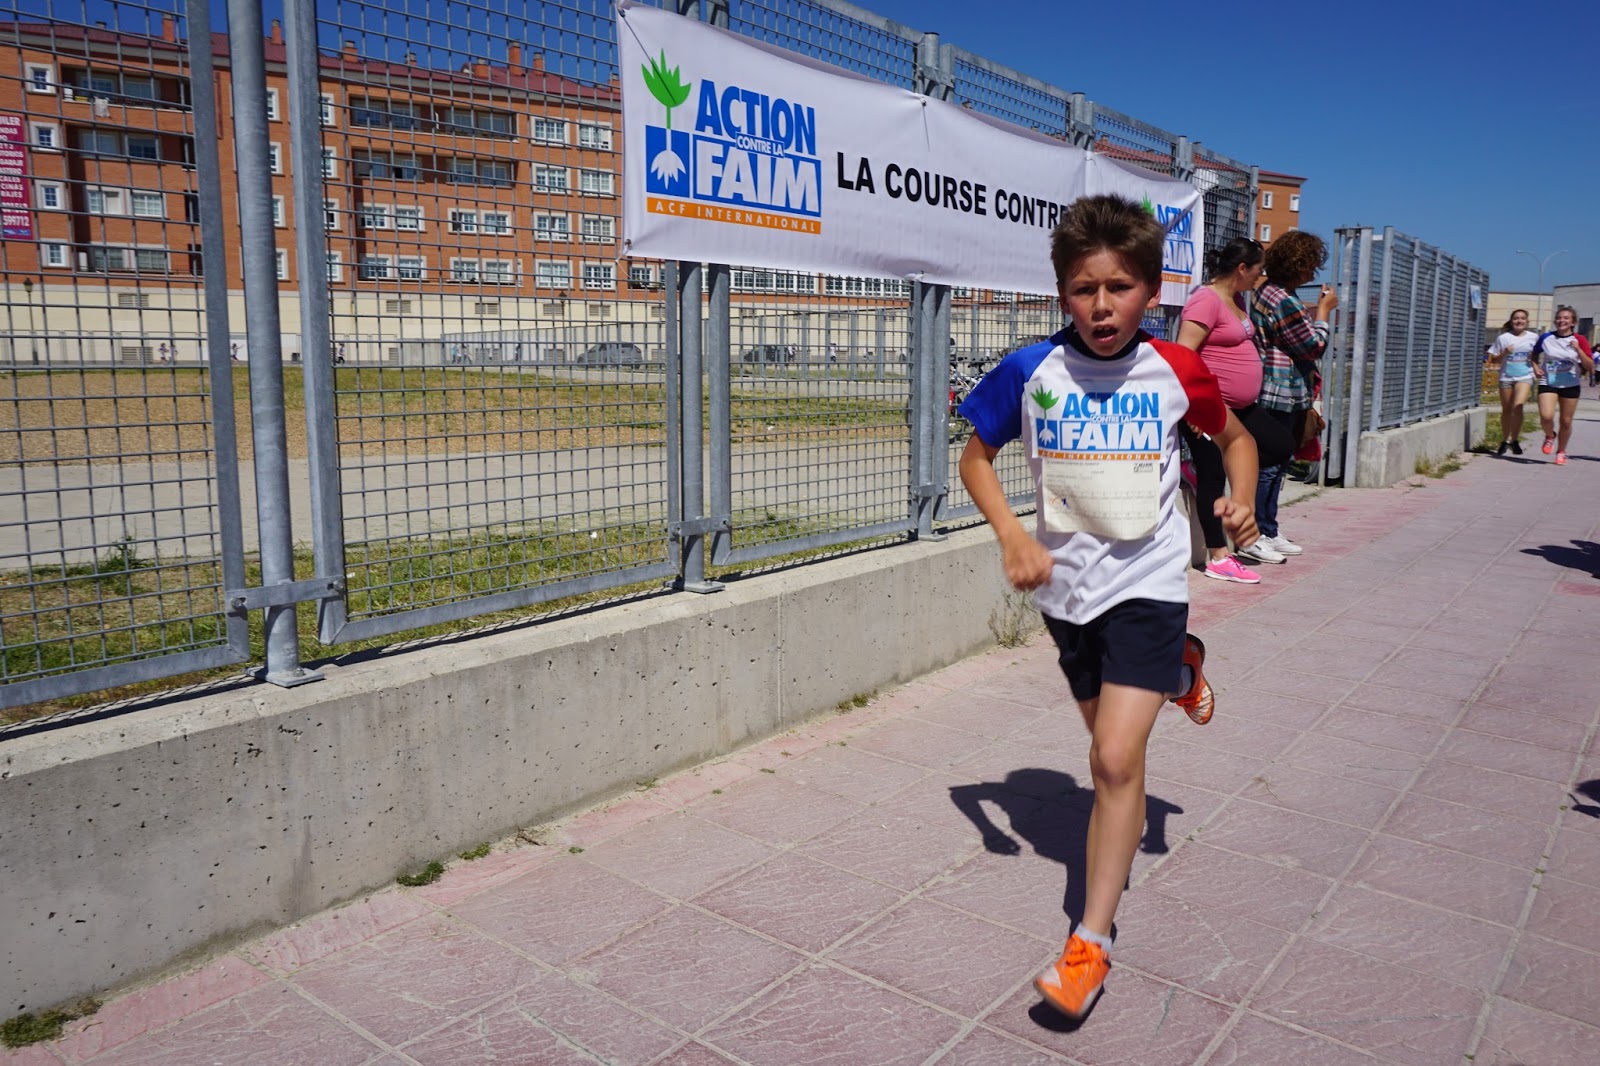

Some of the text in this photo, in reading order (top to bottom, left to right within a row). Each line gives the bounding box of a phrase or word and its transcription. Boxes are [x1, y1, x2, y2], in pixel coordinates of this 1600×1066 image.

[695, 79, 816, 155] ACTION
[737, 135, 784, 156] CONTRE LA
[696, 139, 819, 213] FAIM
[836, 151, 875, 194] LA
[885, 162, 987, 216] COURSE
[655, 201, 815, 232] ACF INTERNATIONAL
[1062, 392, 1160, 419] ACTION
[1090, 415, 1131, 423] CONTRE LA
[1061, 421, 1160, 450] FAIM
